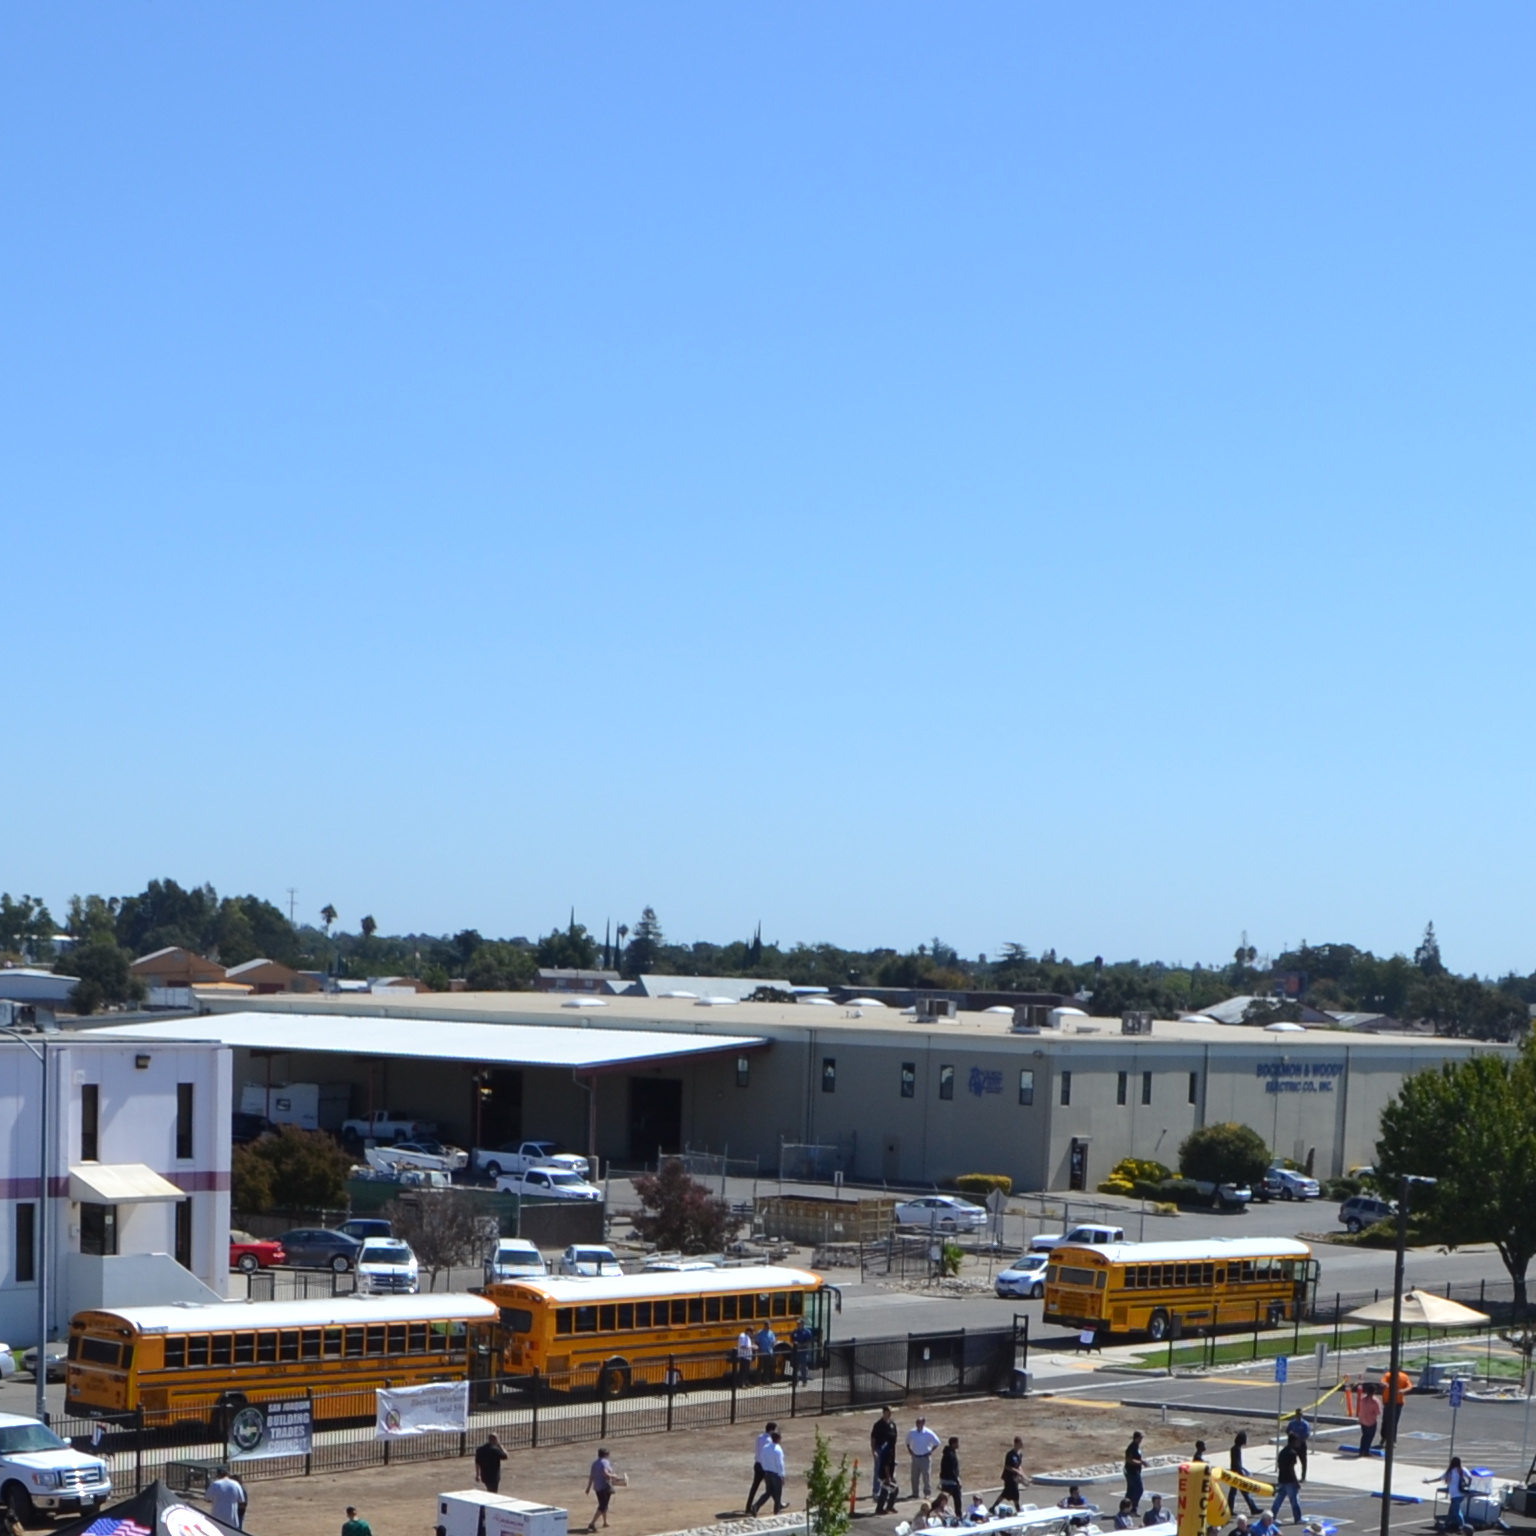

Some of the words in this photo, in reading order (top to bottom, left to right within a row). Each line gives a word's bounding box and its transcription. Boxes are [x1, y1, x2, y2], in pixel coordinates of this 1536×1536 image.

[1312, 1062, 1344, 1077] WOODY
[268, 1403, 282, 1412] SAN
[282, 1400, 311, 1411] JOAQUIN
[267, 1412, 310, 1427] BUILDING
[270, 1425, 305, 1439] TRADES
[267, 1438, 308, 1452] COUNCIL
